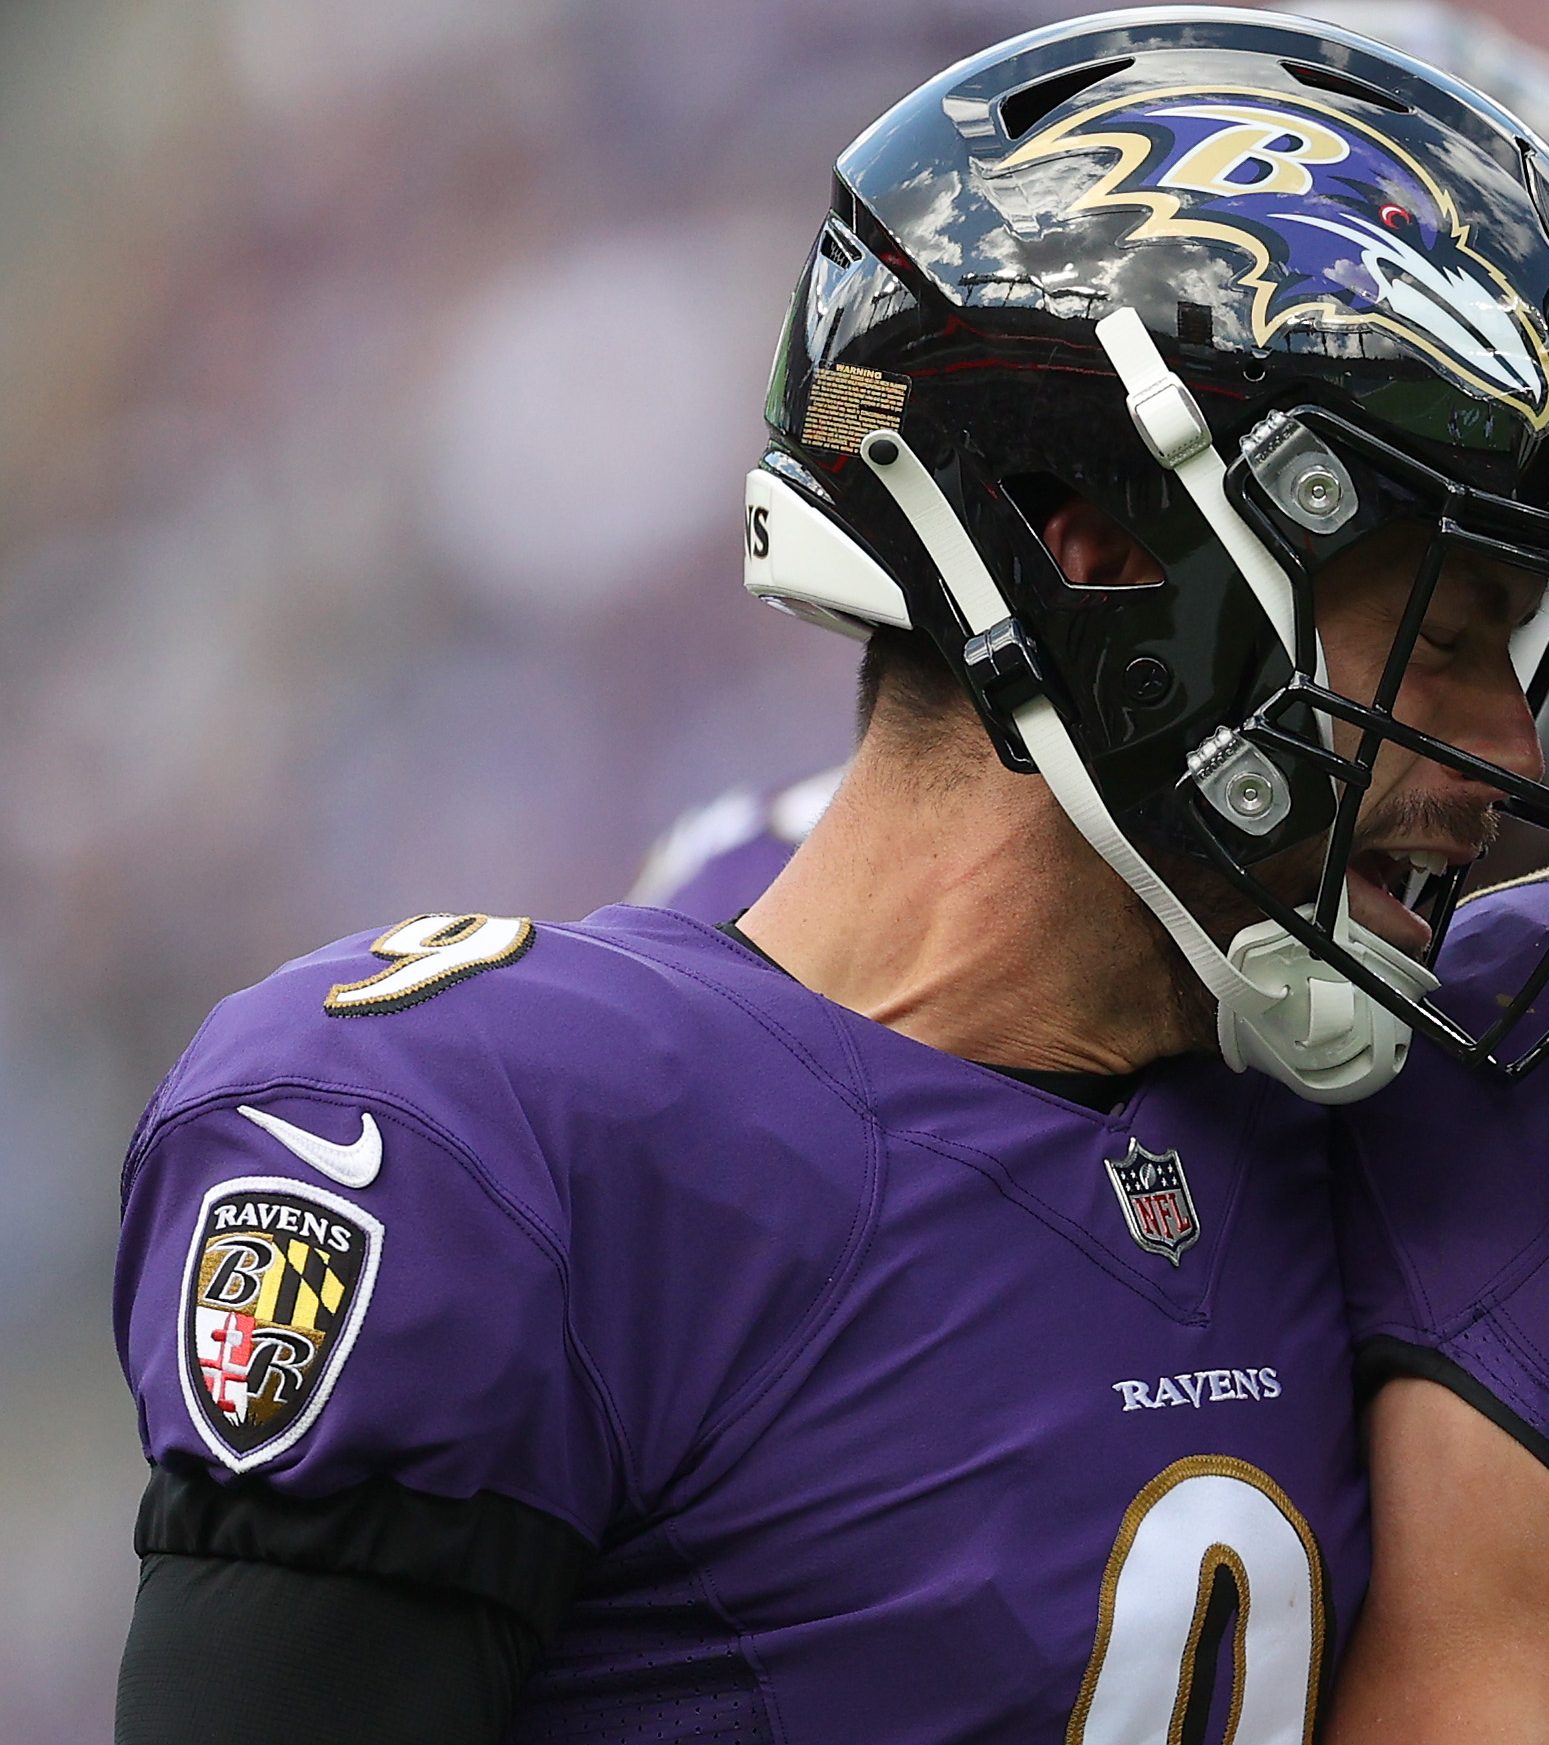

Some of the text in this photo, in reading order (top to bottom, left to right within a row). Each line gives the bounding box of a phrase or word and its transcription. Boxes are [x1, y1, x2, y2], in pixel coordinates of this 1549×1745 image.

[1144, 104, 1350, 197] B
[836, 363, 882, 380] WARNING
[324, 912, 537, 1019] 9
[213, 1202, 352, 1252] RAVENS
[1134, 1192, 1192, 1239] NFL
[203, 1234, 276, 1308] B
[248, 1327, 316, 1404] R
[1112, 1367, 1283, 1412] RAVENS
